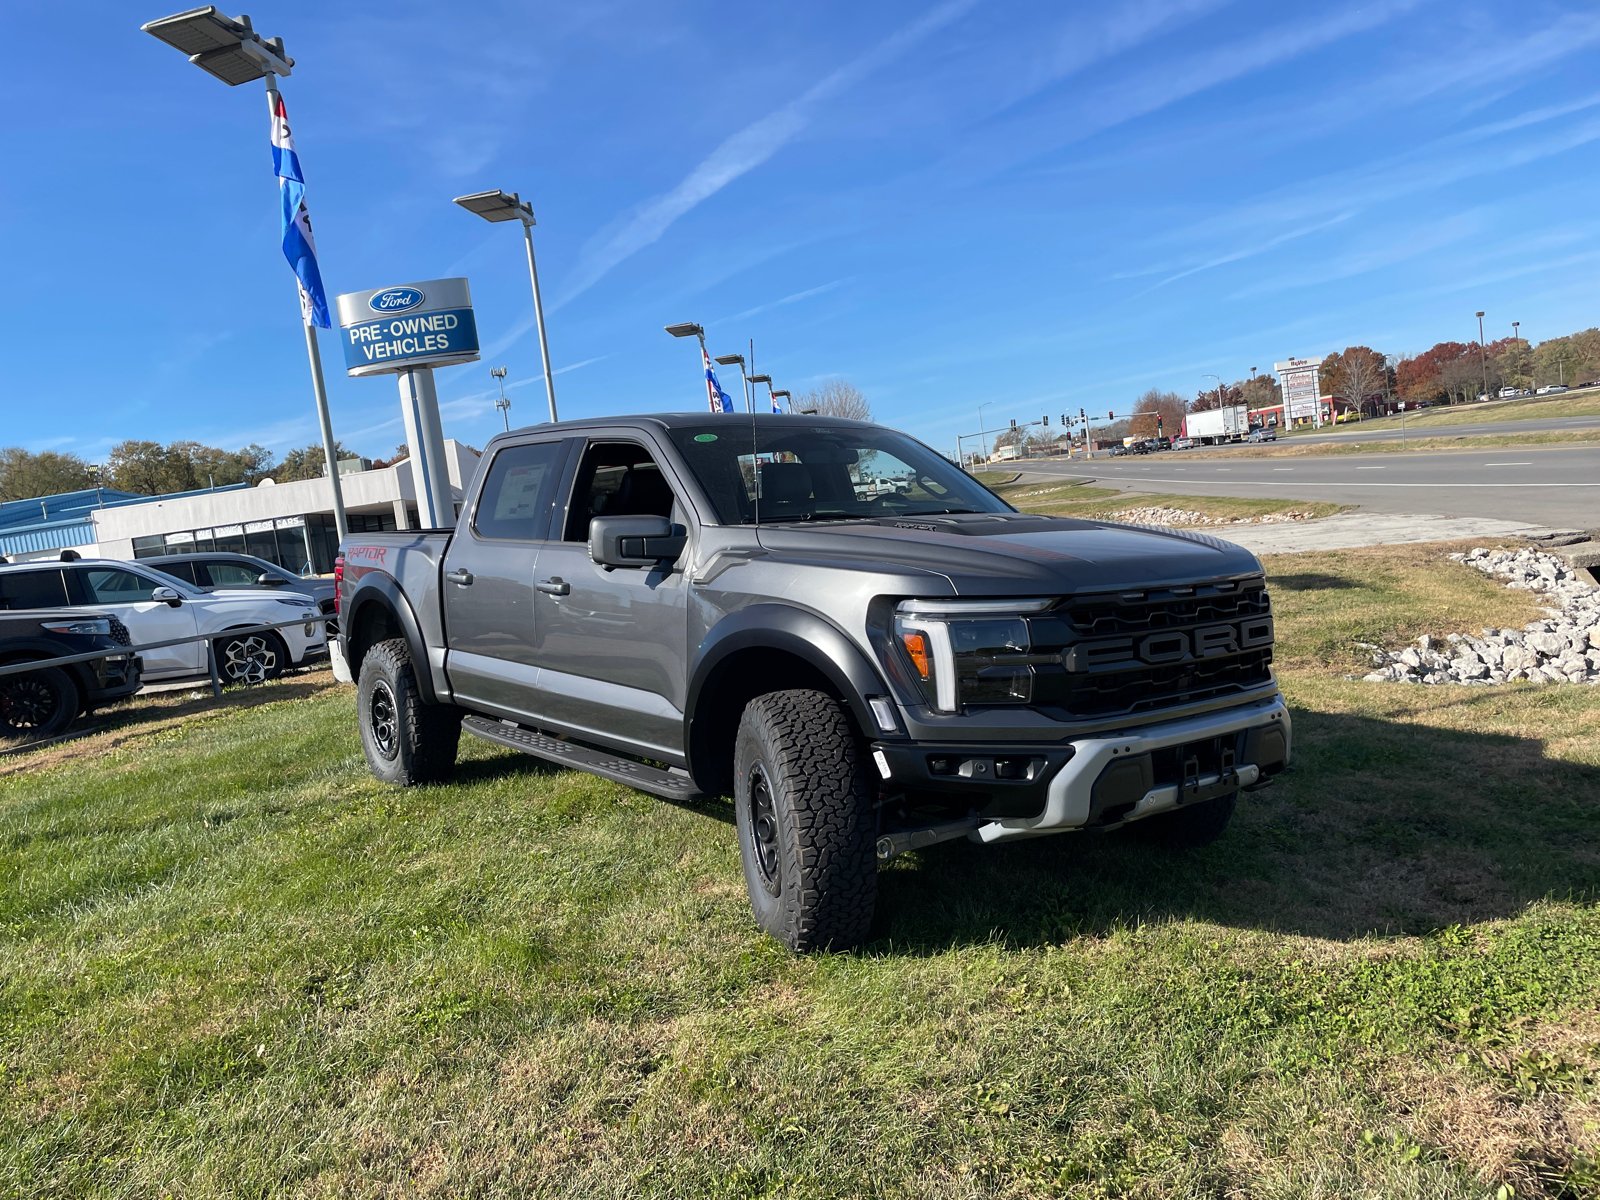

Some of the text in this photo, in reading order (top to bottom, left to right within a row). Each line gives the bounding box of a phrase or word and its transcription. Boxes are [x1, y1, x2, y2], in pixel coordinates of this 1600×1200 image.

[380, 292, 412, 308] Ford
[350, 314, 458, 345] PRE-OWNED
[363, 334, 449, 360] VEHICLES
[276, 517, 299, 527] CARS
[347, 546, 388, 567] RAPTOR
[1061, 617, 1275, 674] FORD
